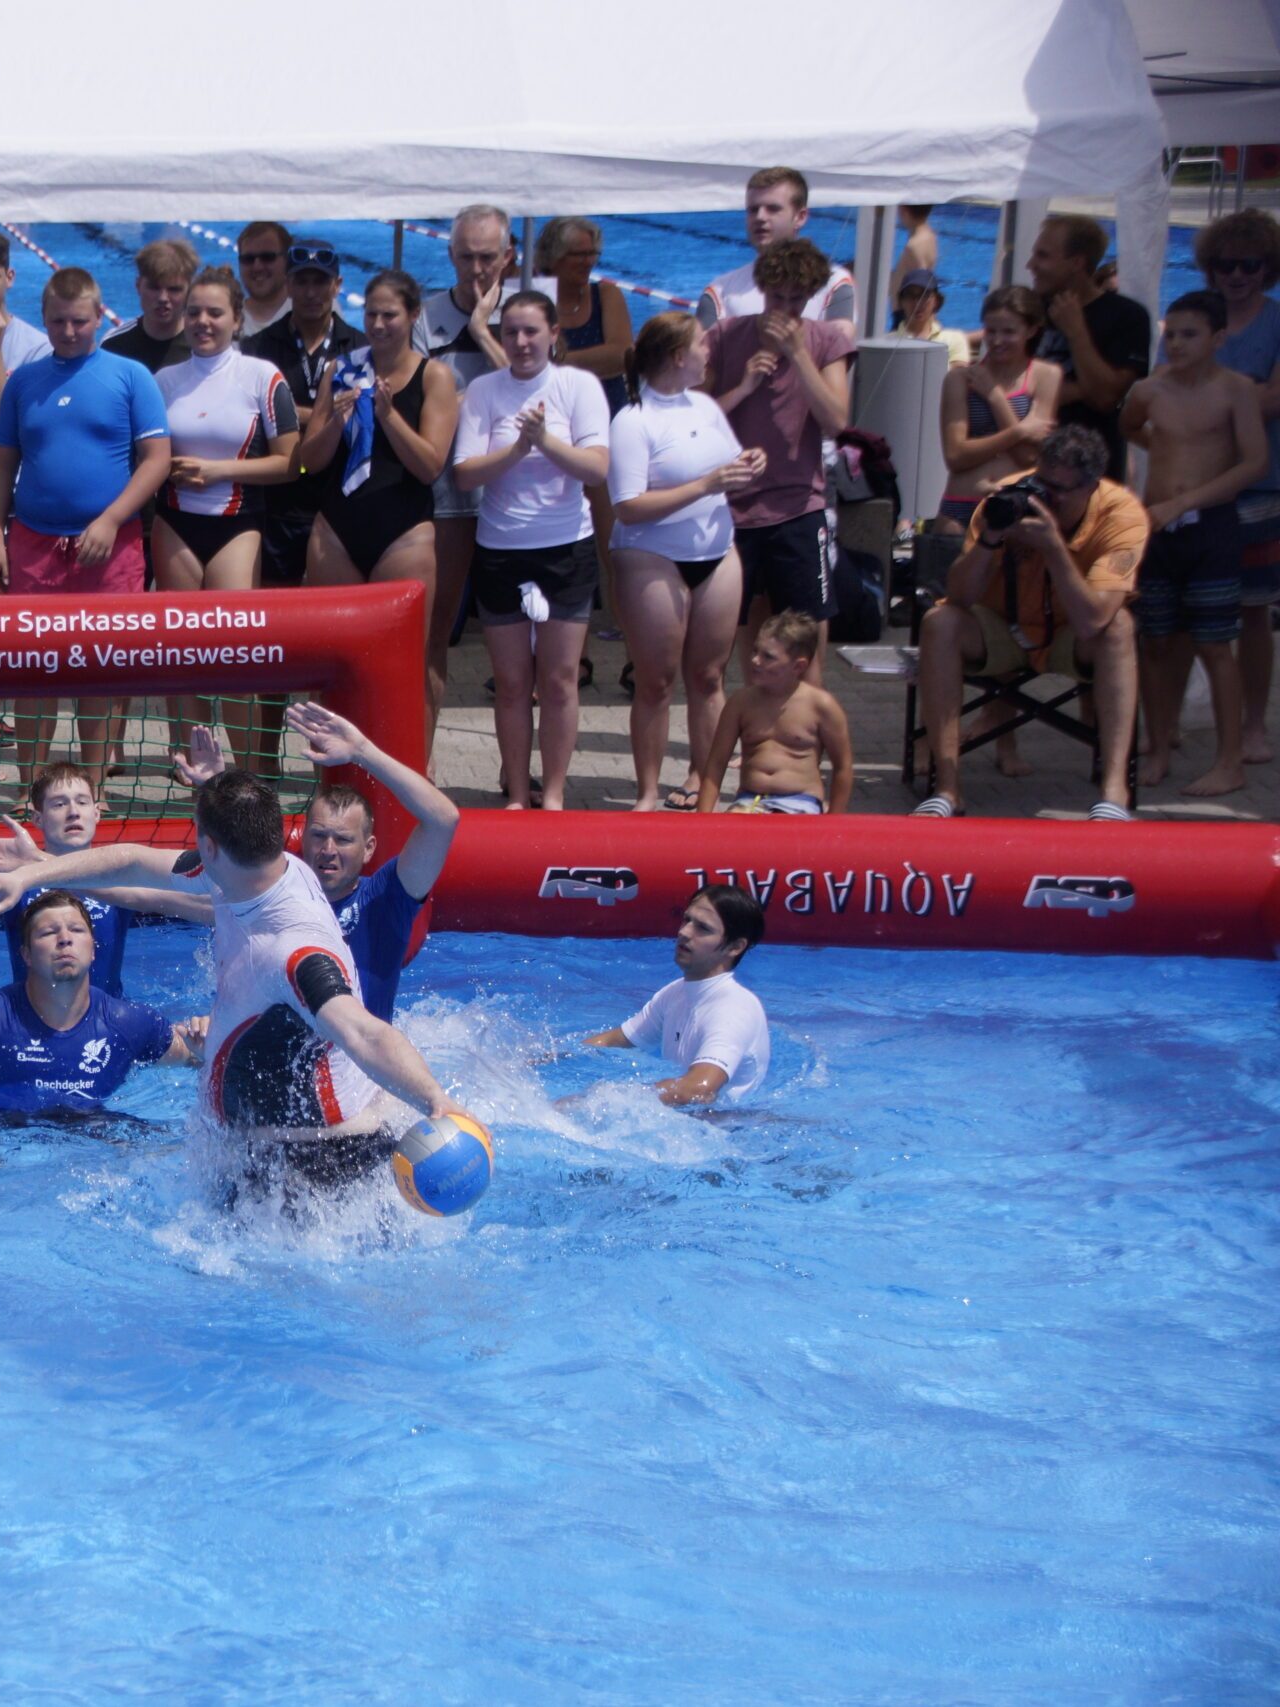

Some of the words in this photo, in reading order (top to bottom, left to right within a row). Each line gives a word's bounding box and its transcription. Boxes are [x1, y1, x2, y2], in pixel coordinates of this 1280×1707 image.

[17, 609, 156, 638] Sparkasse
[165, 606, 266, 630] Dachau
[68, 645, 87, 668] &
[94, 642, 284, 667] Vereinswesen
[35, 1079, 95, 1090] Dachdecker
